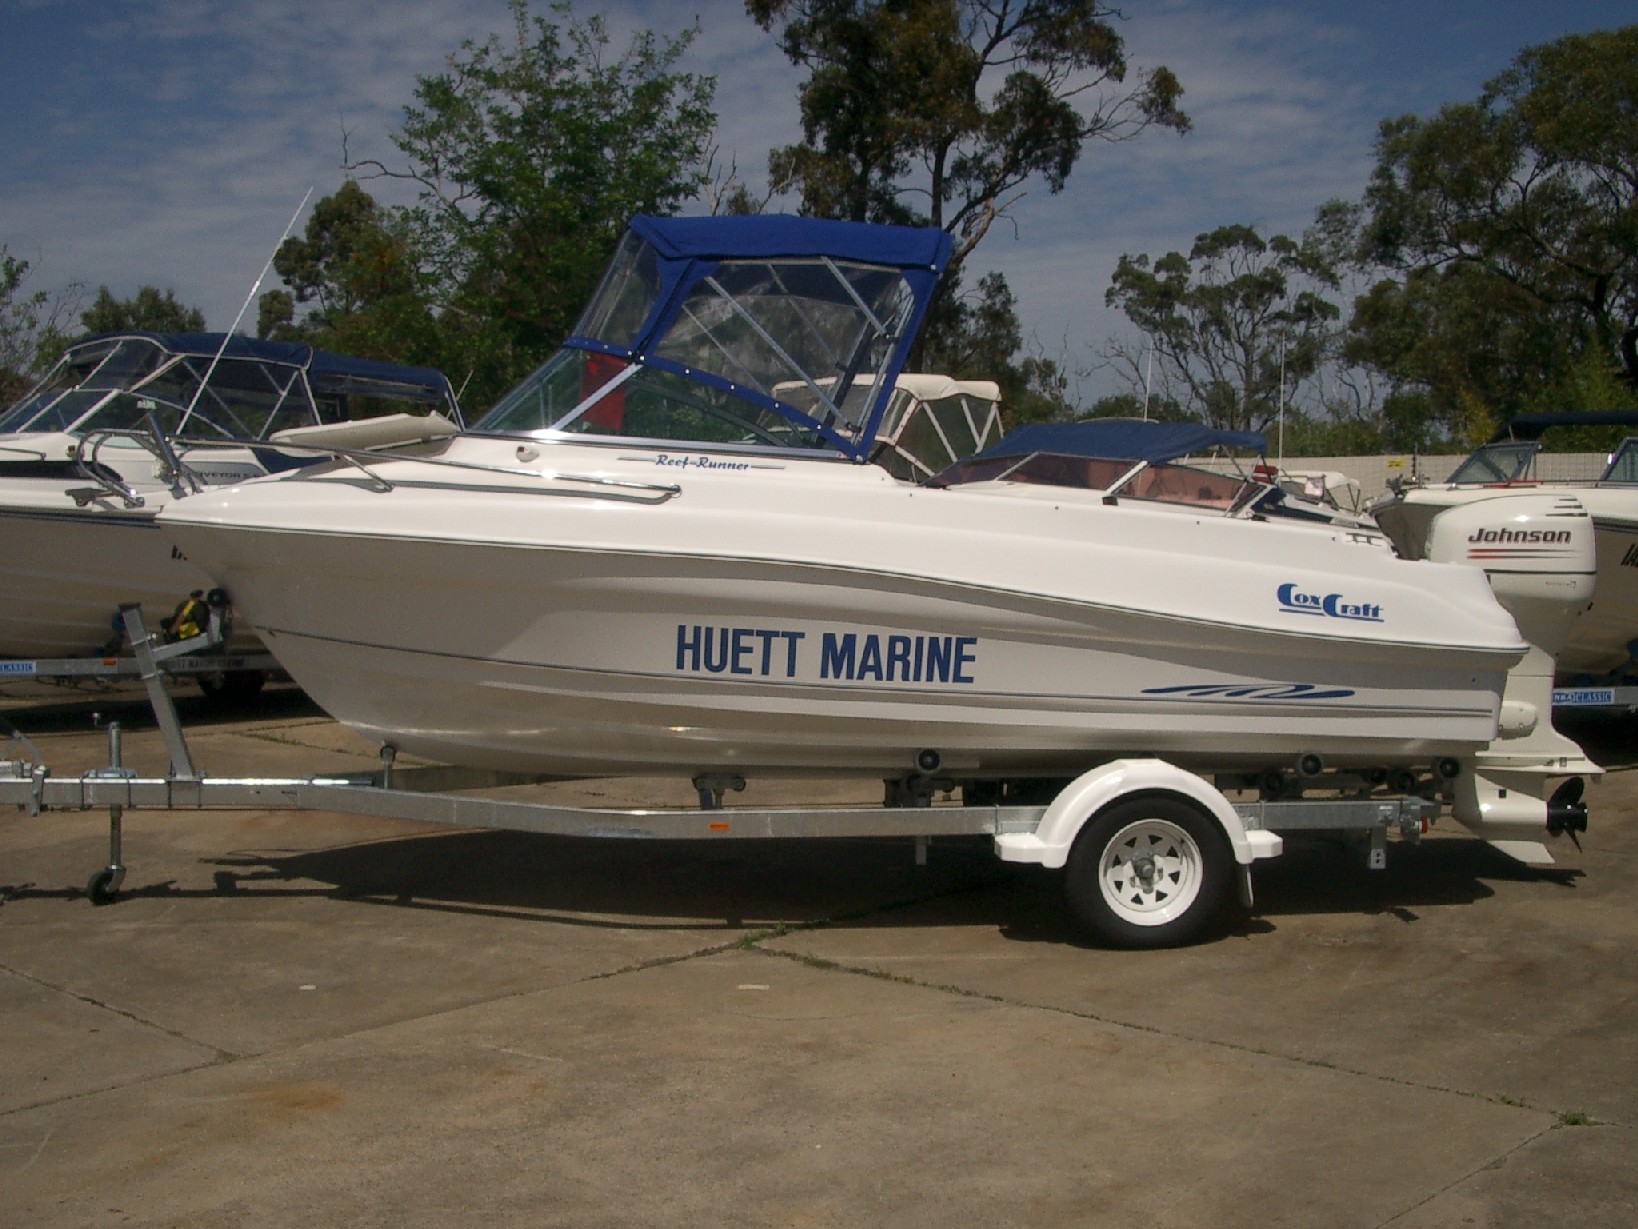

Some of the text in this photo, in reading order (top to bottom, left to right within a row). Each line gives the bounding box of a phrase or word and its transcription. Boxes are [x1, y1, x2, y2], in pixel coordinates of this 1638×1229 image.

[656, 454, 749, 470] Reef Runner
[1467, 527, 1572, 544] Johnson
[676, 625, 978, 684] HUETT MARINE
